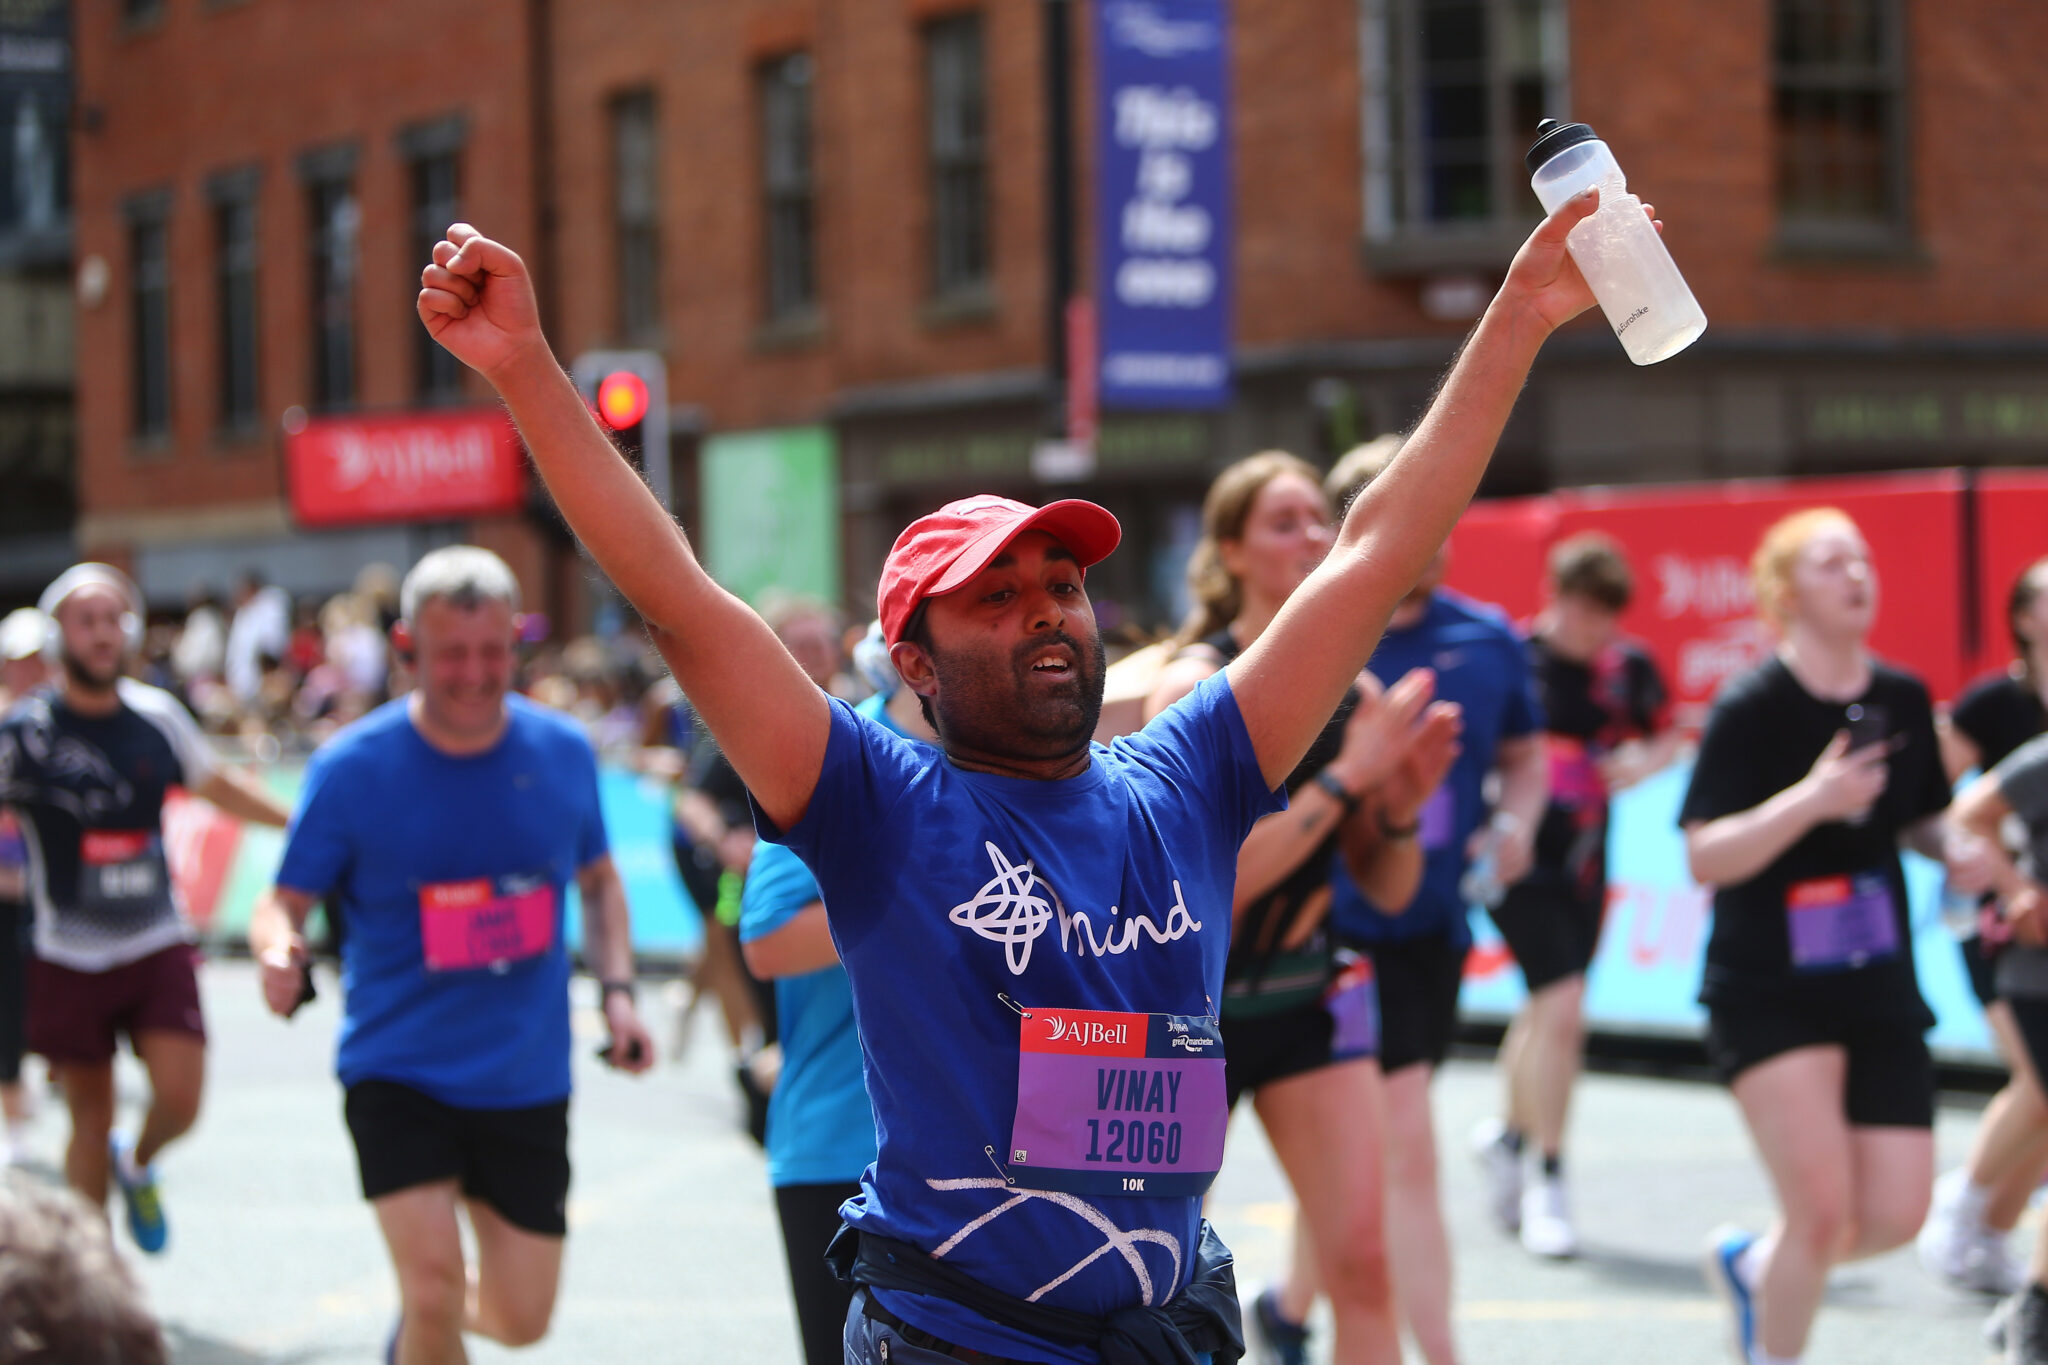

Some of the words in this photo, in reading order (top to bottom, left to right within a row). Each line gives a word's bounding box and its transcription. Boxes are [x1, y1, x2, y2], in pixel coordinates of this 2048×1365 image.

[1620, 306, 1648, 331] Eurohike
[1055, 879, 1202, 957] mind
[1172, 1037, 1186, 1047] great
[1188, 1037, 1214, 1046] manchester
[1097, 1068, 1182, 1114] VINAY
[1085, 1119, 1182, 1165] 12060
[1122, 1178, 1145, 1192] 10K
